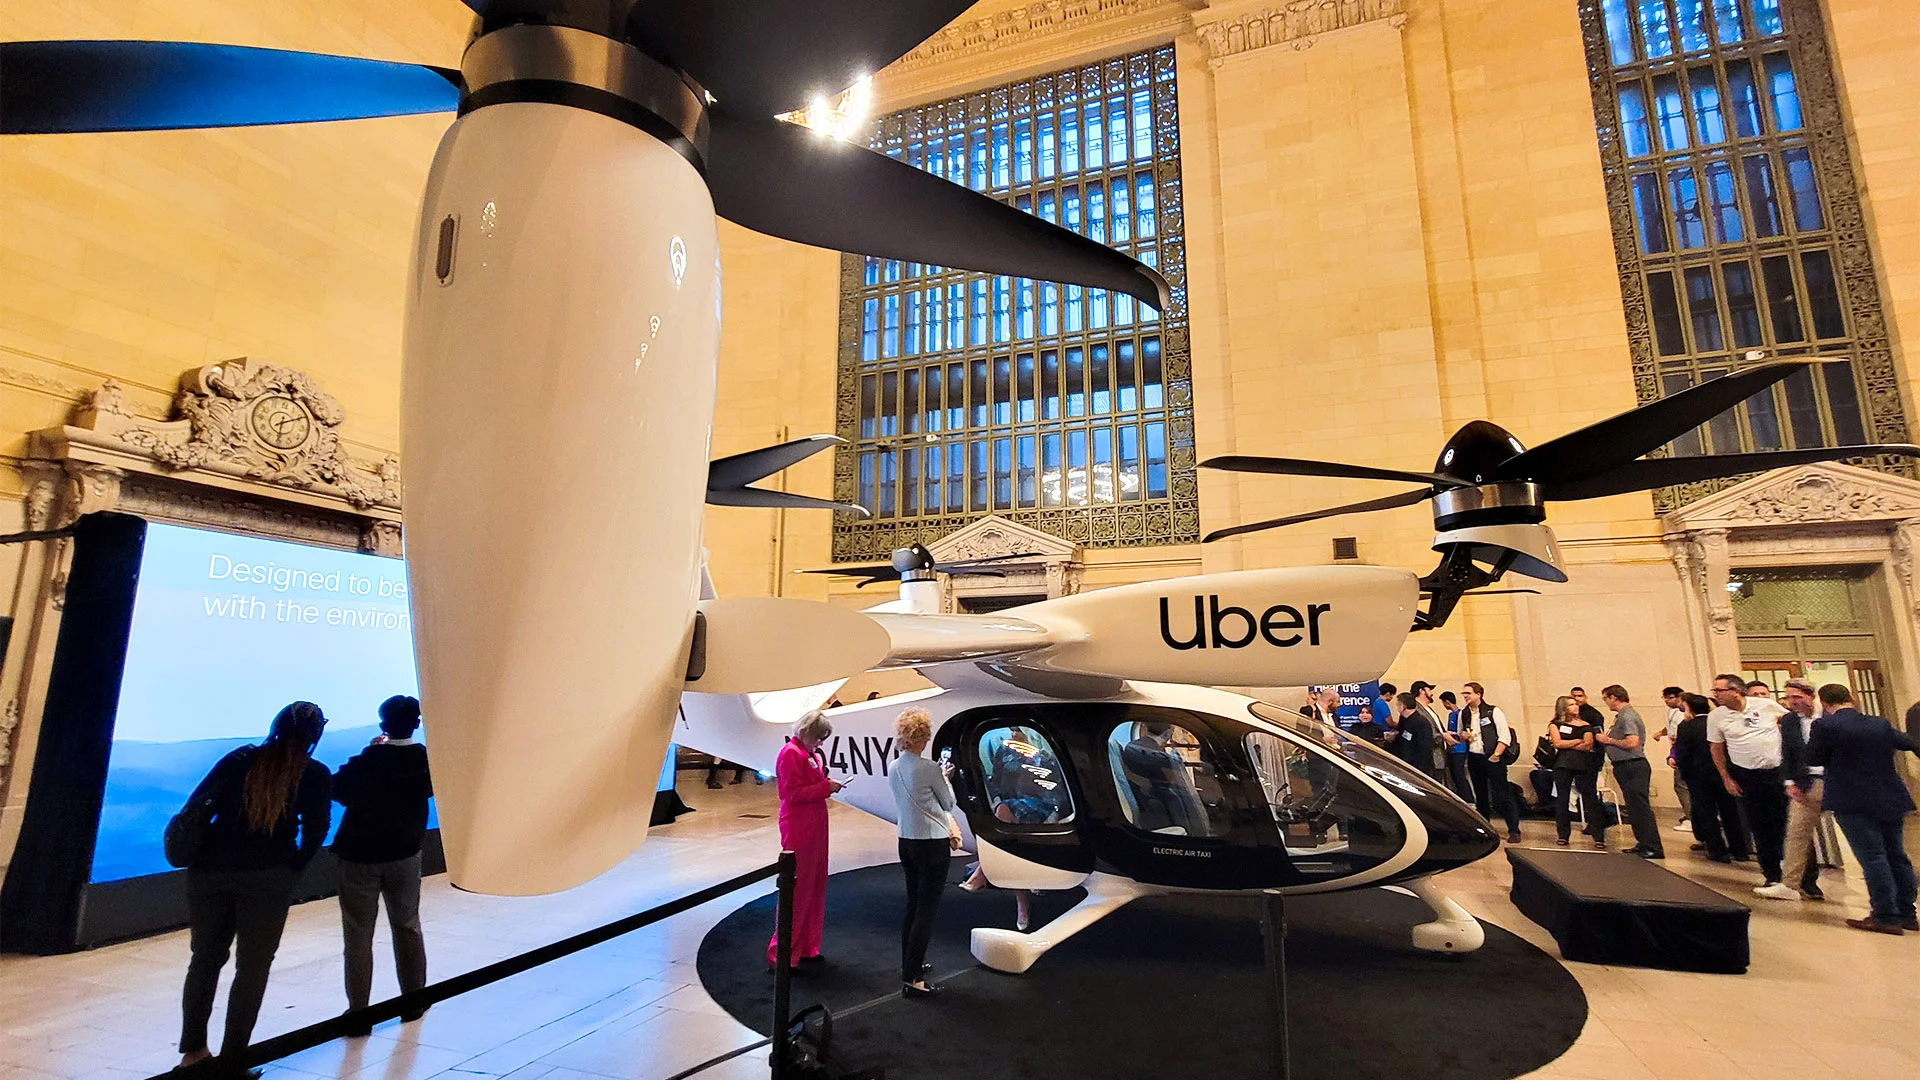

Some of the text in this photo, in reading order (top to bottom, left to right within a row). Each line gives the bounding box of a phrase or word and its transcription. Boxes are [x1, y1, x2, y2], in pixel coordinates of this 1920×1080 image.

[208, 553, 406, 599] Designed to be
[203, 594, 410, 630] with the environ
[1159, 594, 1331, 650] Uber
[1153, 847, 1211, 858] ELECTRIC AIR TAXI
